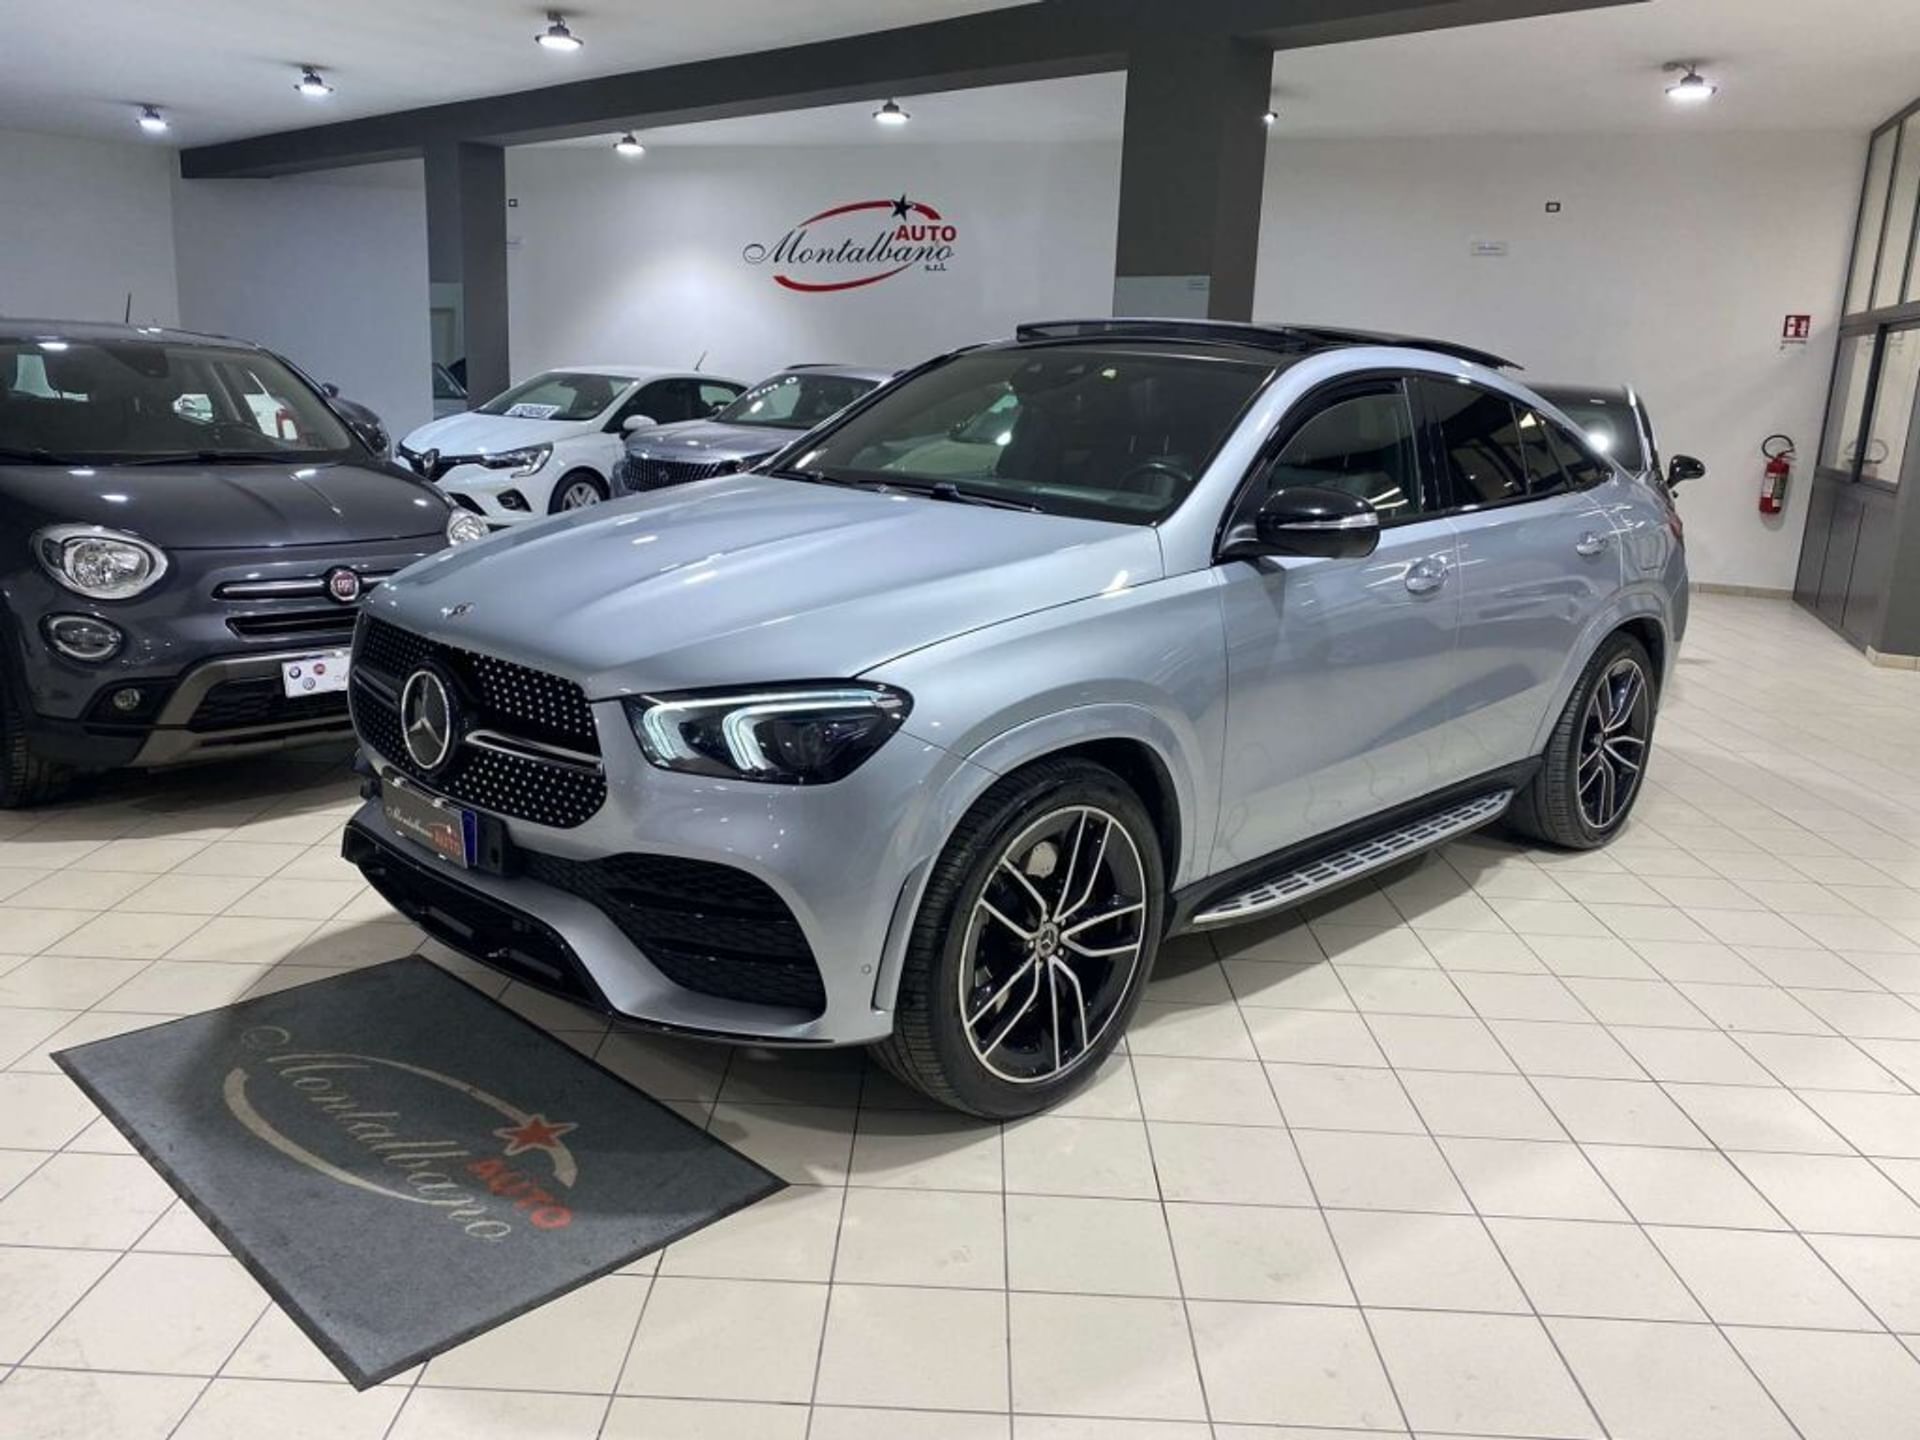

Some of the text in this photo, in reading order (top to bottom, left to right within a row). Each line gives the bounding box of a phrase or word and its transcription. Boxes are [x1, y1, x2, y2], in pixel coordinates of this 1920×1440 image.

[742, 228, 954, 264] Montalbano
[895, 224, 957, 242] AUTO
[240, 1024, 512, 1242] Montalbano
[465, 1157, 573, 1231] AUTO
